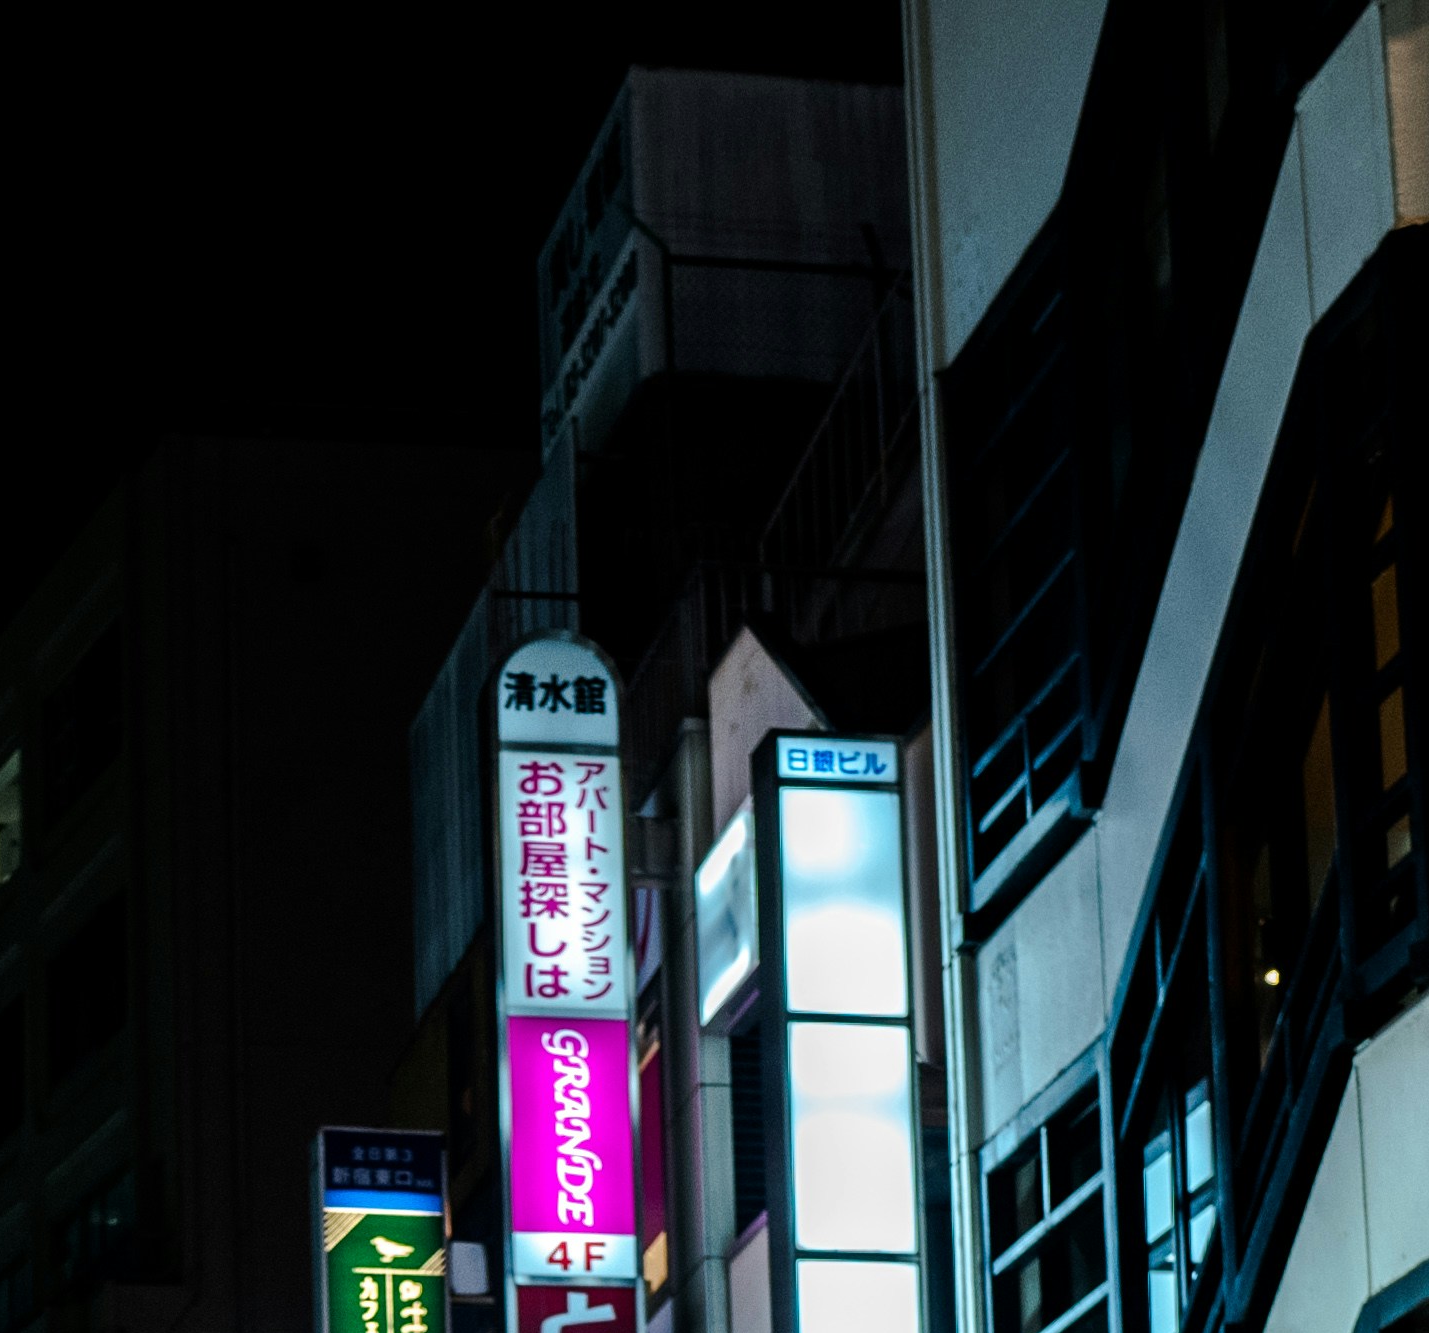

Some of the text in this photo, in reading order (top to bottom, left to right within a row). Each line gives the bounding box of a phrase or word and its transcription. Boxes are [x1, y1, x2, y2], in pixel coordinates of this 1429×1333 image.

[504, 671, 607, 715] 清水館
[517, 761, 571, 999] お部屋探しは
[575, 761, 613, 1001] アパート・マンション
[541, 1029, 602, 1227] GRANDE
